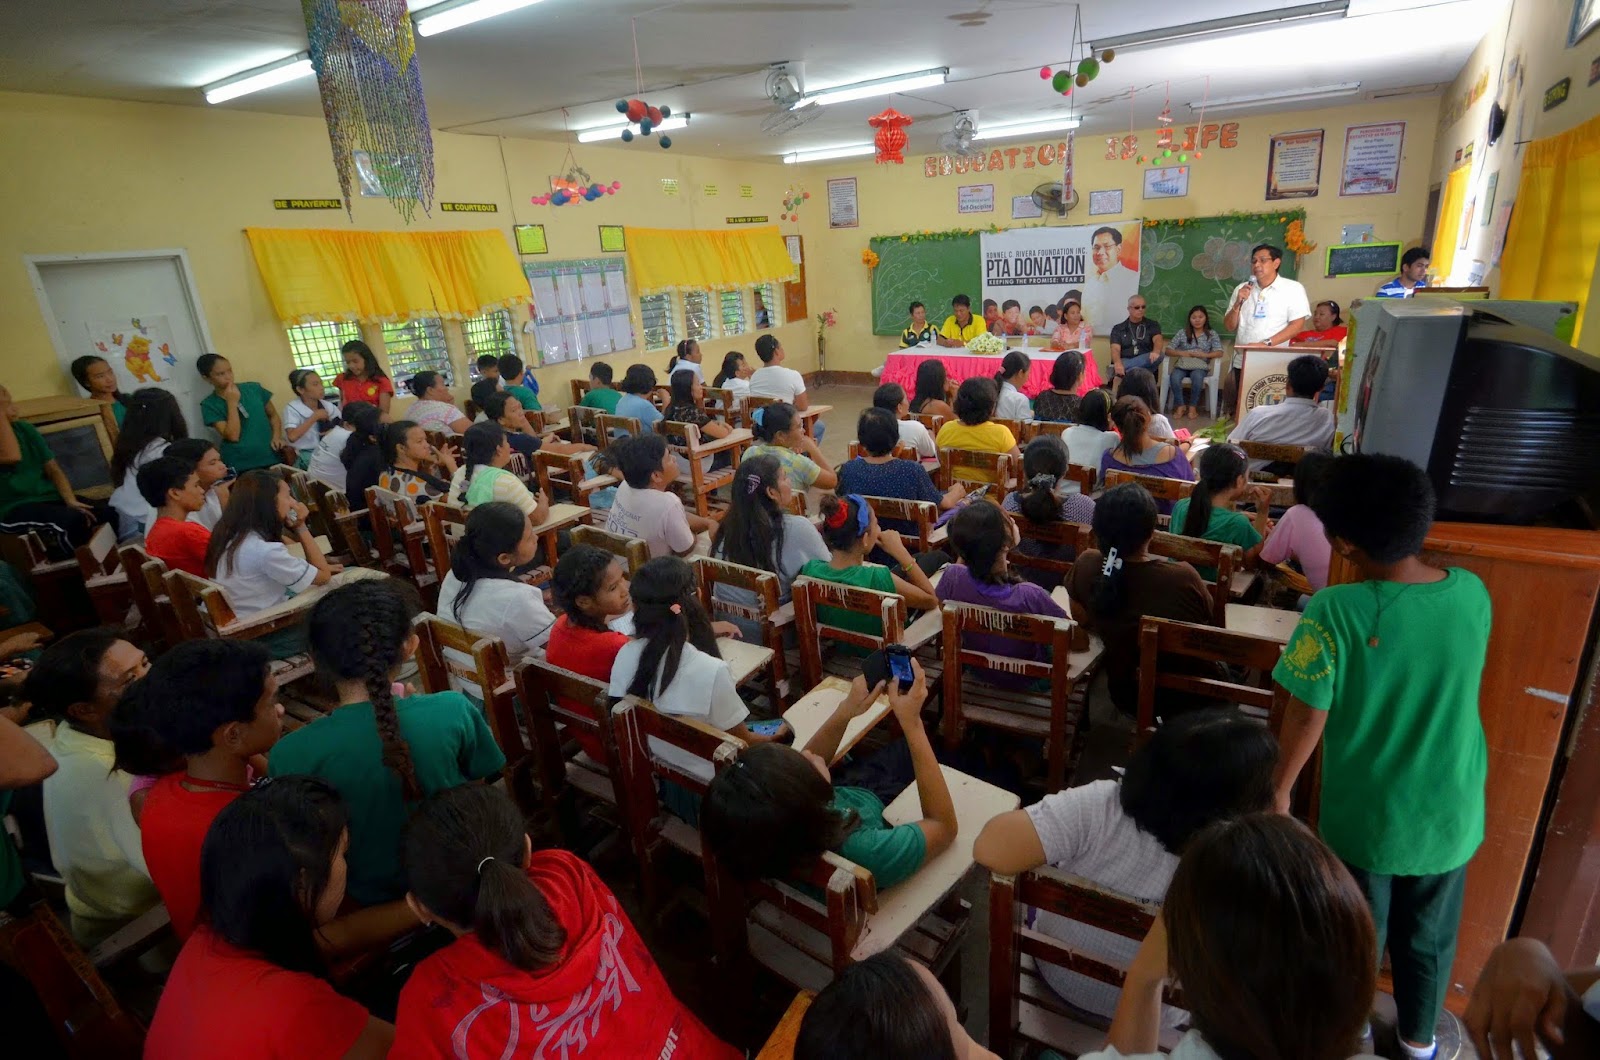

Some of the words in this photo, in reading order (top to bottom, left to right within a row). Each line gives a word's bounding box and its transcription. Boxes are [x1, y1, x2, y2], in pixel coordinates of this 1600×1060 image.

[1105, 135, 1139, 161] IS
[275, 201, 287, 209] BE
[291, 200, 341, 209] PRAYERFUL
[455, 204, 496, 212] COURTEOUS
[1038, 248, 1074, 257] FOUNDATION
[1075, 247, 1088, 255] INC.
[986, 259, 1010, 278] PTA
[1015, 255, 1085, 277] DONATION
[1253, 379, 1267, 393] HIGH
[1267, 376, 1288, 384] SCHOO
